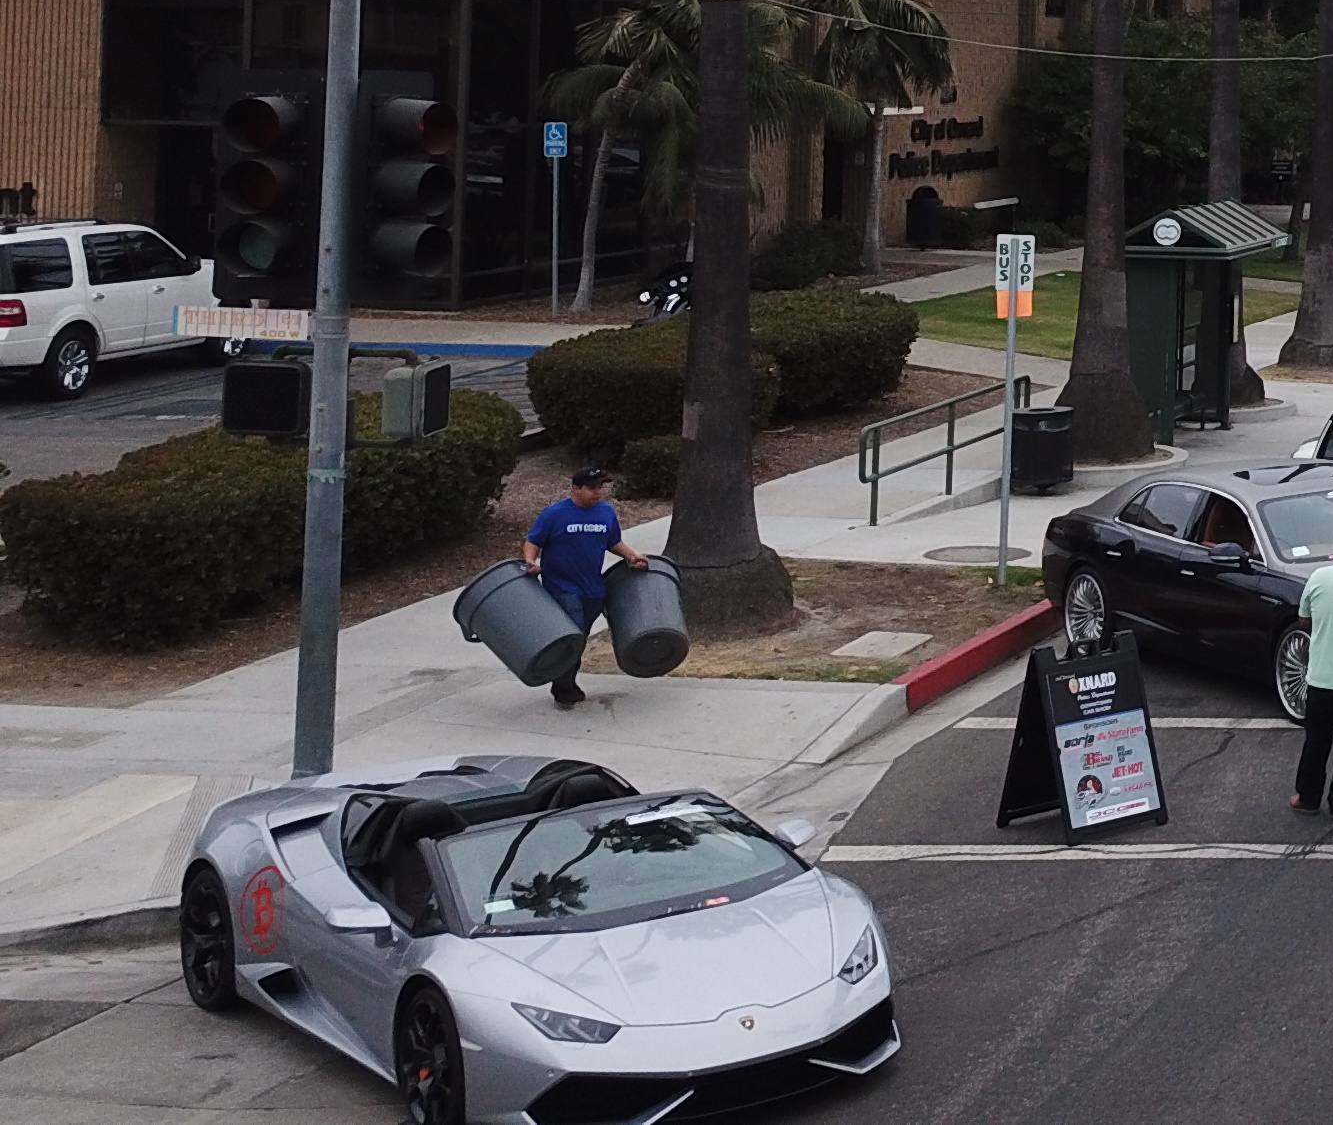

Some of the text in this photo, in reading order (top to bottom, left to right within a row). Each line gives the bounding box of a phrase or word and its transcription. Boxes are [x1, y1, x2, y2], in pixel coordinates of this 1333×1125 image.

[999, 243, 1009, 282] BUS
[1019, 240, 1032, 285] STOP
[260, 330, 286, 338] 400
